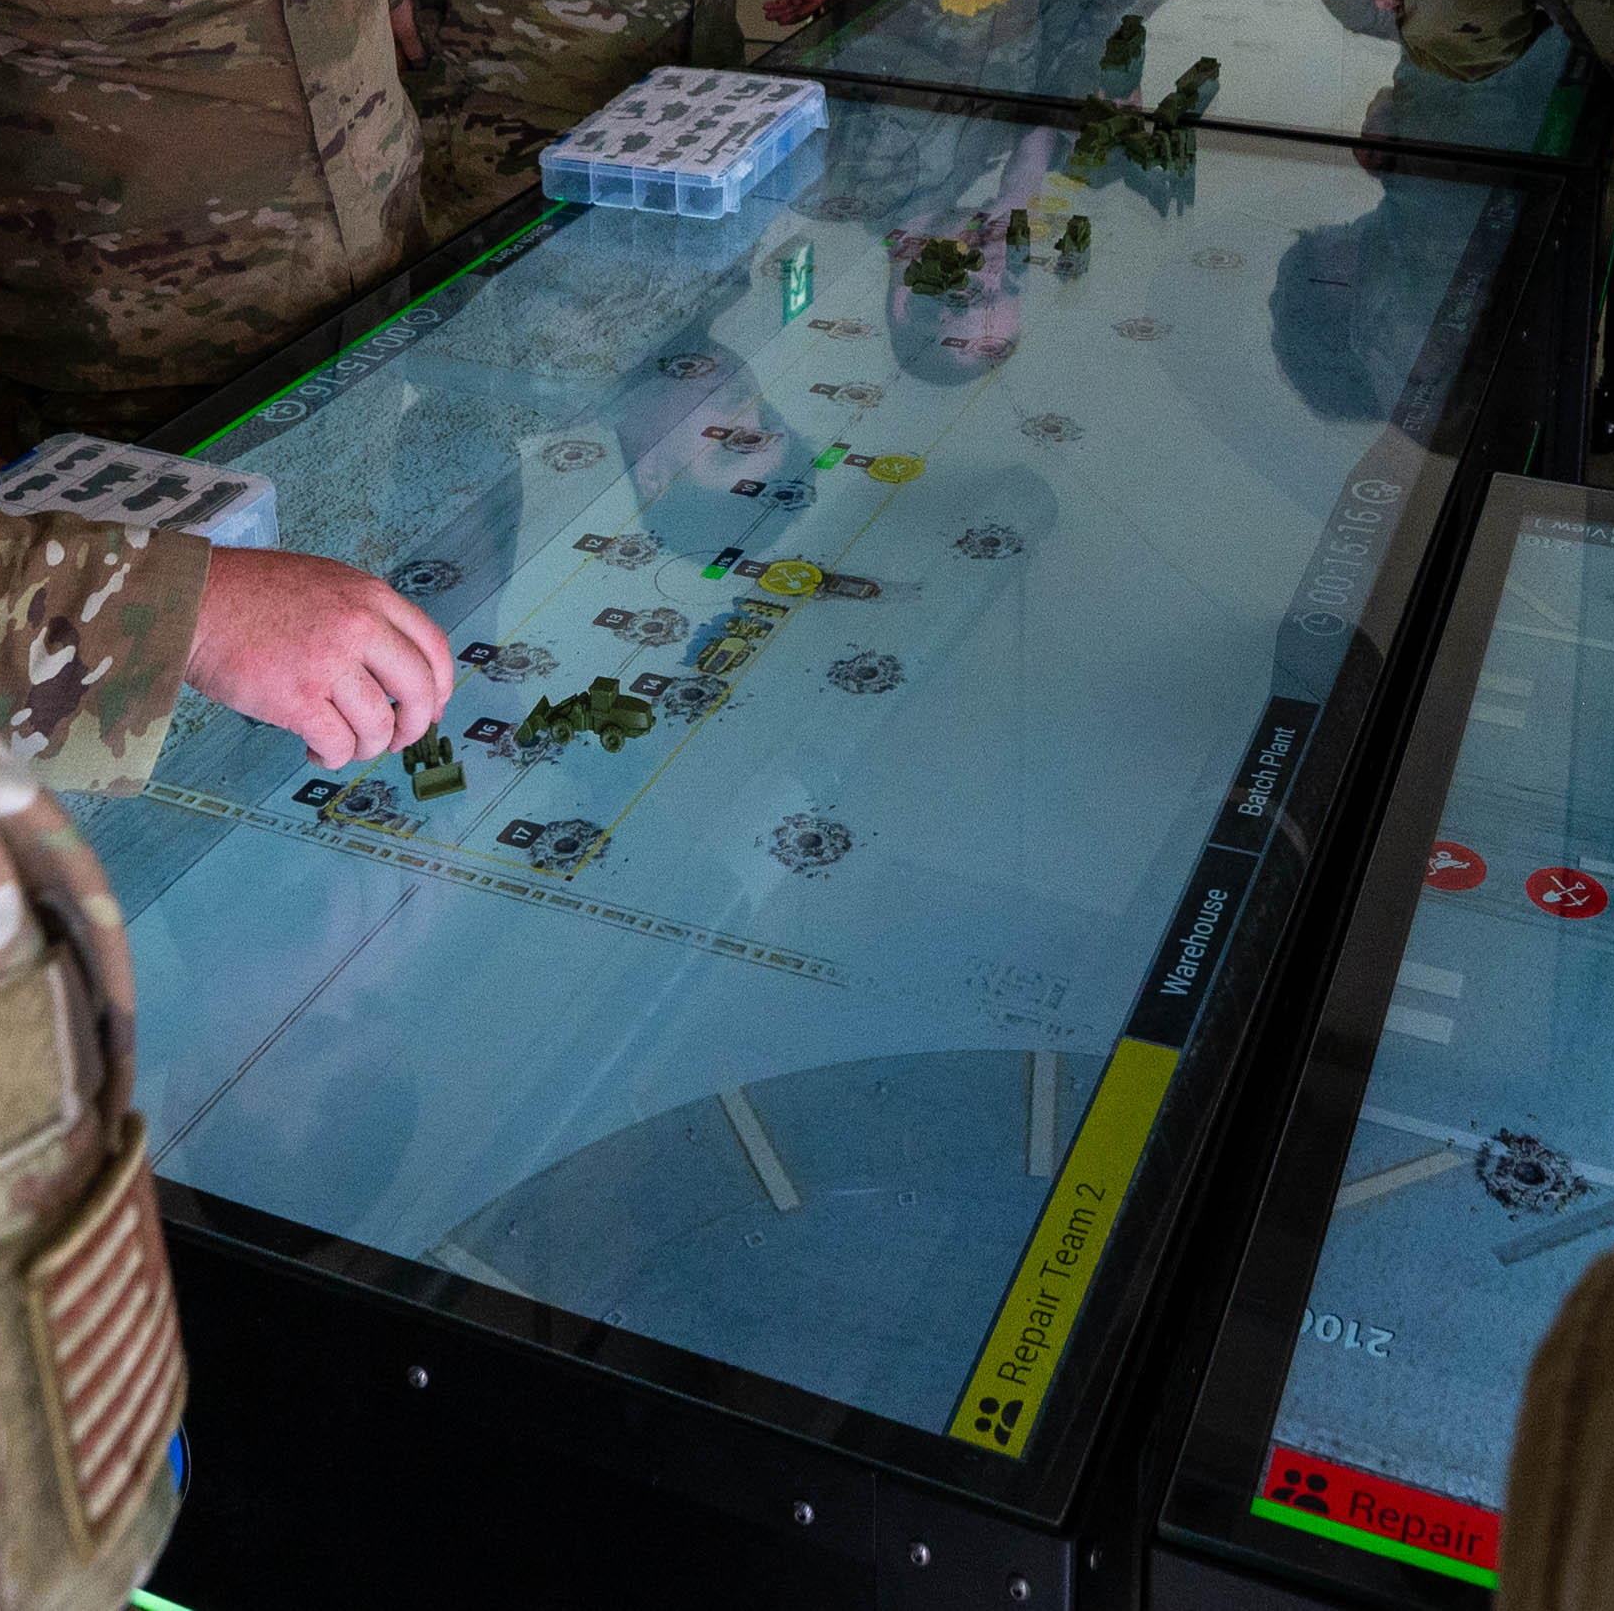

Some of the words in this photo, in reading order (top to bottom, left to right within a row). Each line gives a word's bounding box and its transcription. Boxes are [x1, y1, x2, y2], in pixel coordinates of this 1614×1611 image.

[298, 327, 417, 398] 00:15:16
[746, 482, 759, 493] 10
[1551, 521, 1607, 539] View
[585, 538, 603, 550] 12
[1308, 508, 1382, 606] 00:15:16
[745, 564, 762, 574] 11
[606, 612, 624, 625] 13
[471, 648, 489, 661] 15
[642, 678, 662, 691] 14
[478, 723, 499, 737] 16
[1238, 768, 1279, 817] Batch
[1259, 726, 1297, 769] Plant
[307, 786, 328, 801] 18
[512, 826, 532, 842] 17
[1160, 888, 1229, 996] Warehouse
[997, 1288, 1061, 1387] Repair
[1039, 1207, 1097, 1279] Team
[1075, 1182, 1106, 1202] 2
[1349, 1490, 1483, 1556] Repair
